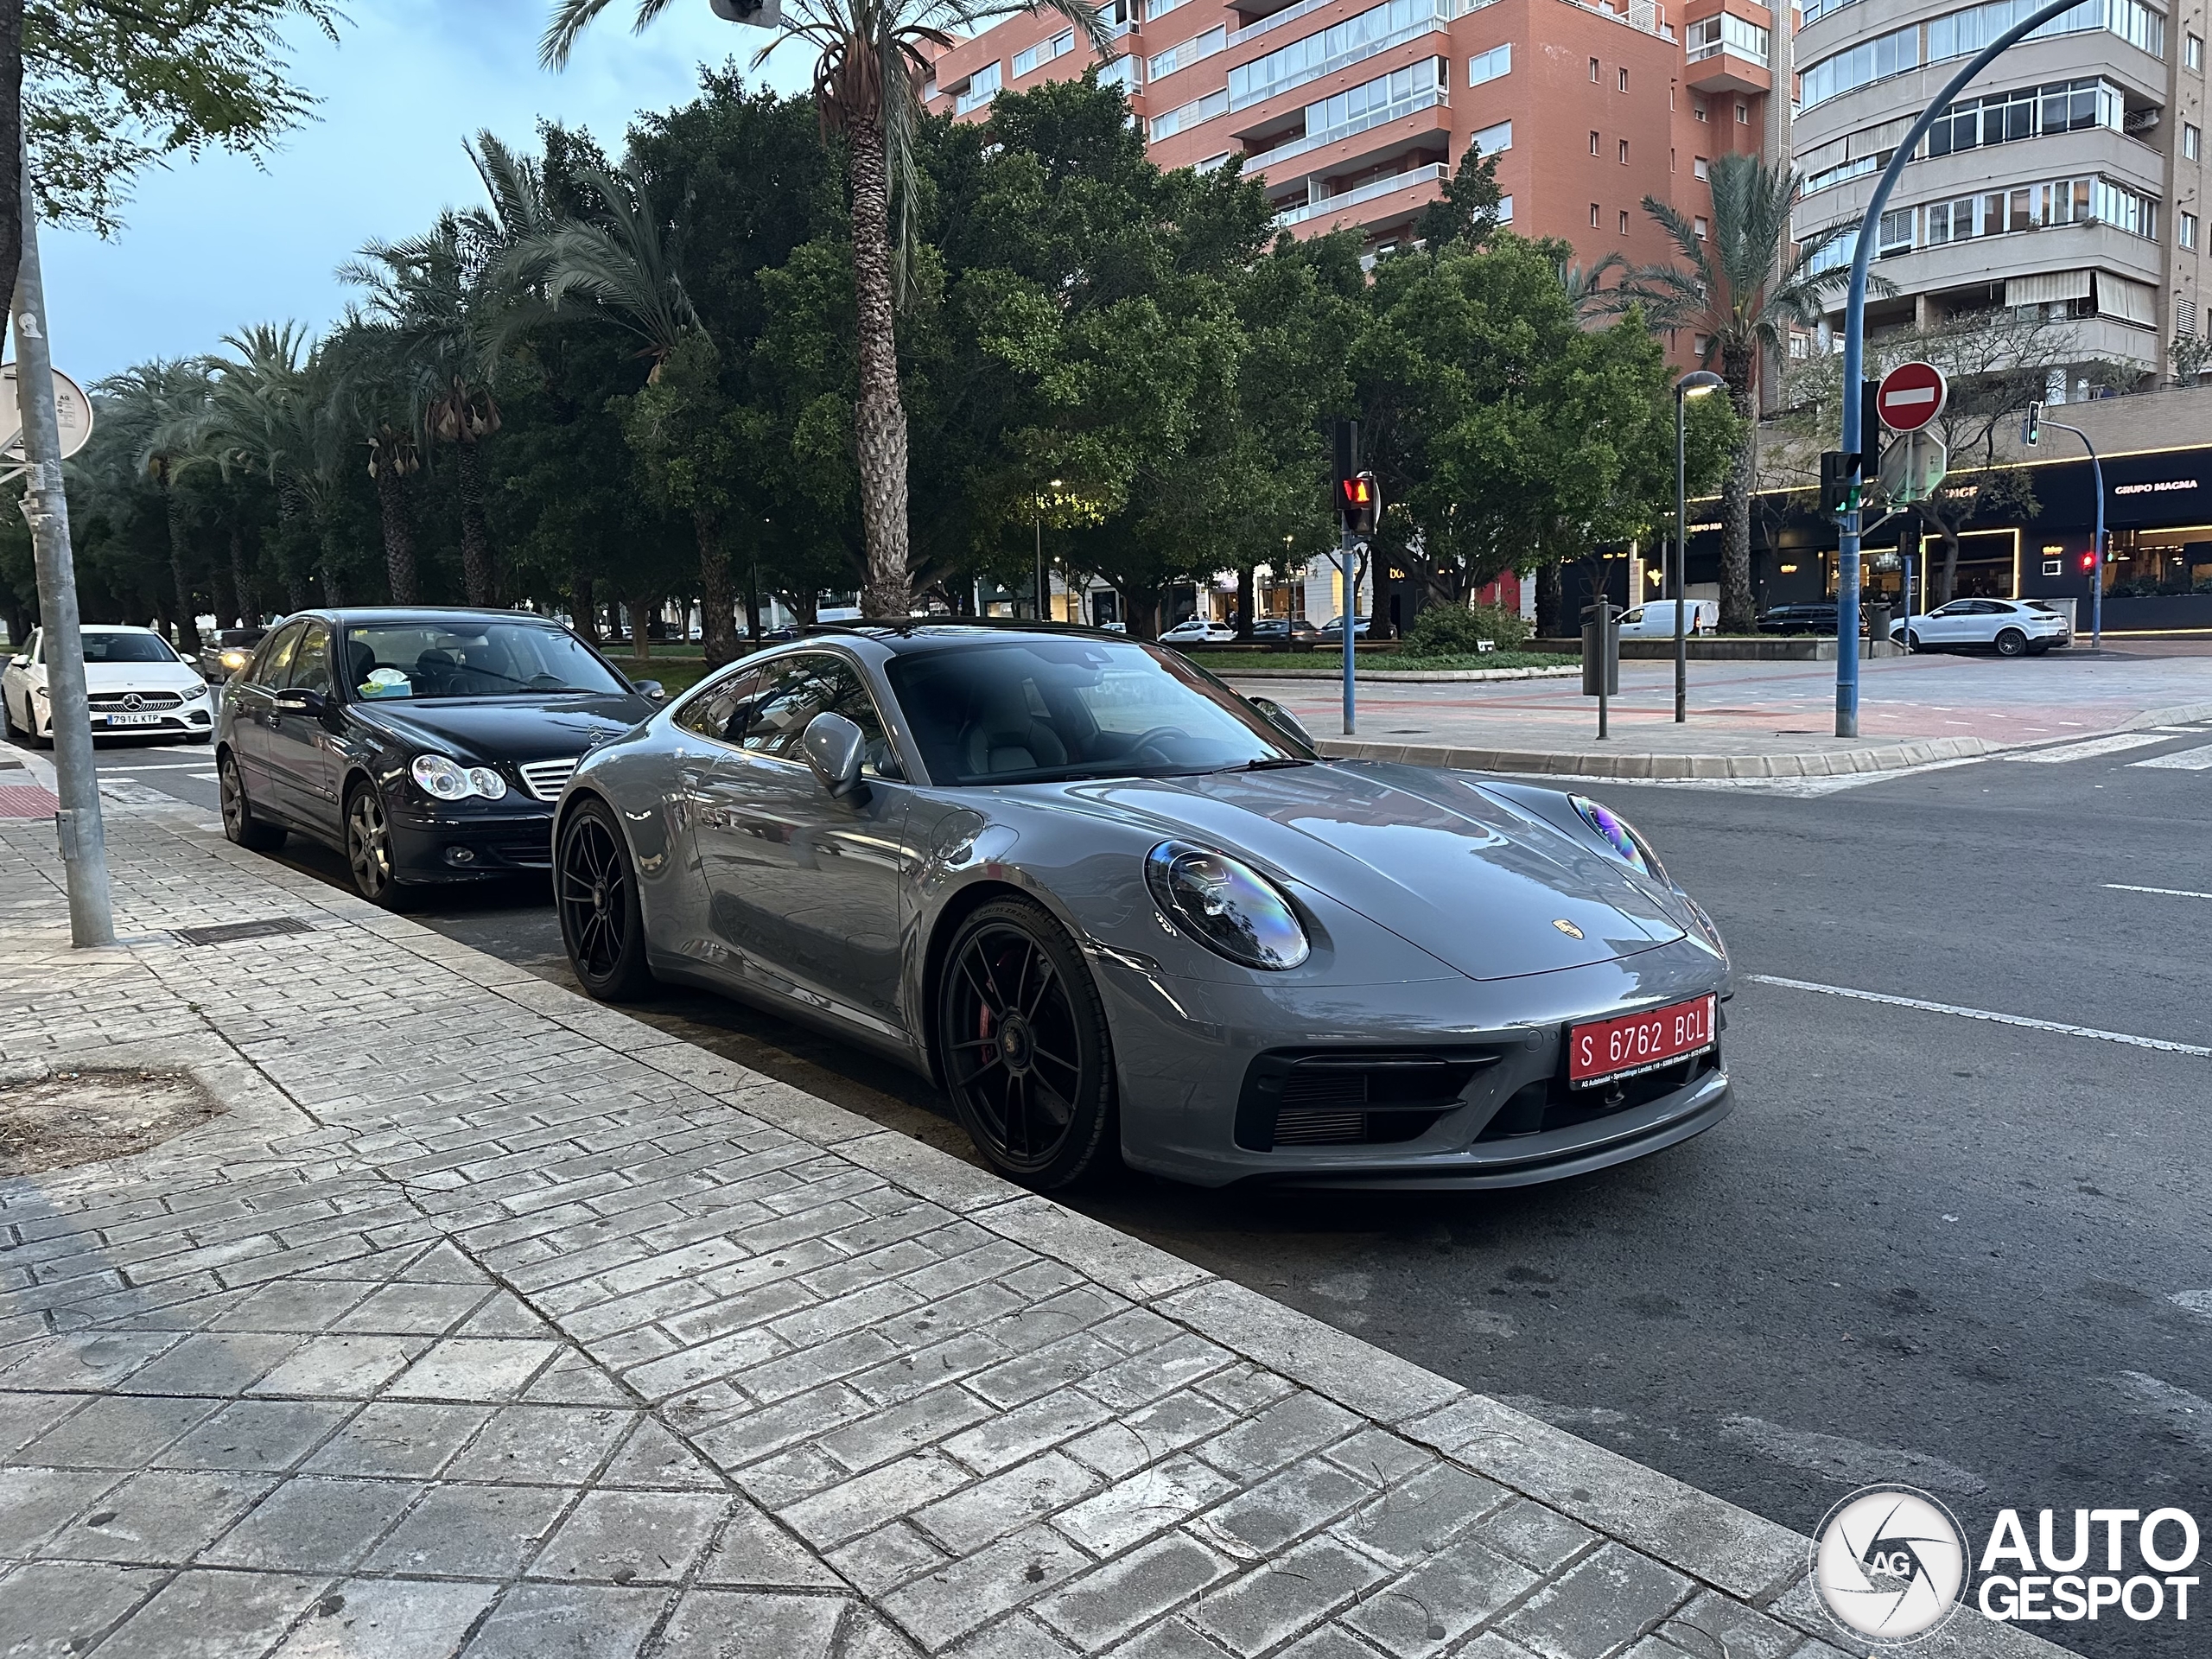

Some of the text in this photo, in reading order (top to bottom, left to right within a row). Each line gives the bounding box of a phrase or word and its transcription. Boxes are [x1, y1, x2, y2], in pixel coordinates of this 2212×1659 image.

[2114, 480, 2198, 495] GRUPO MAGMA
[113, 715, 159, 724] 7914 KTP
[1580, 1035, 1593, 1066] S
[1610, 1022, 1662, 1062] 6762
[1675, 1010, 1705, 1046] BCL
